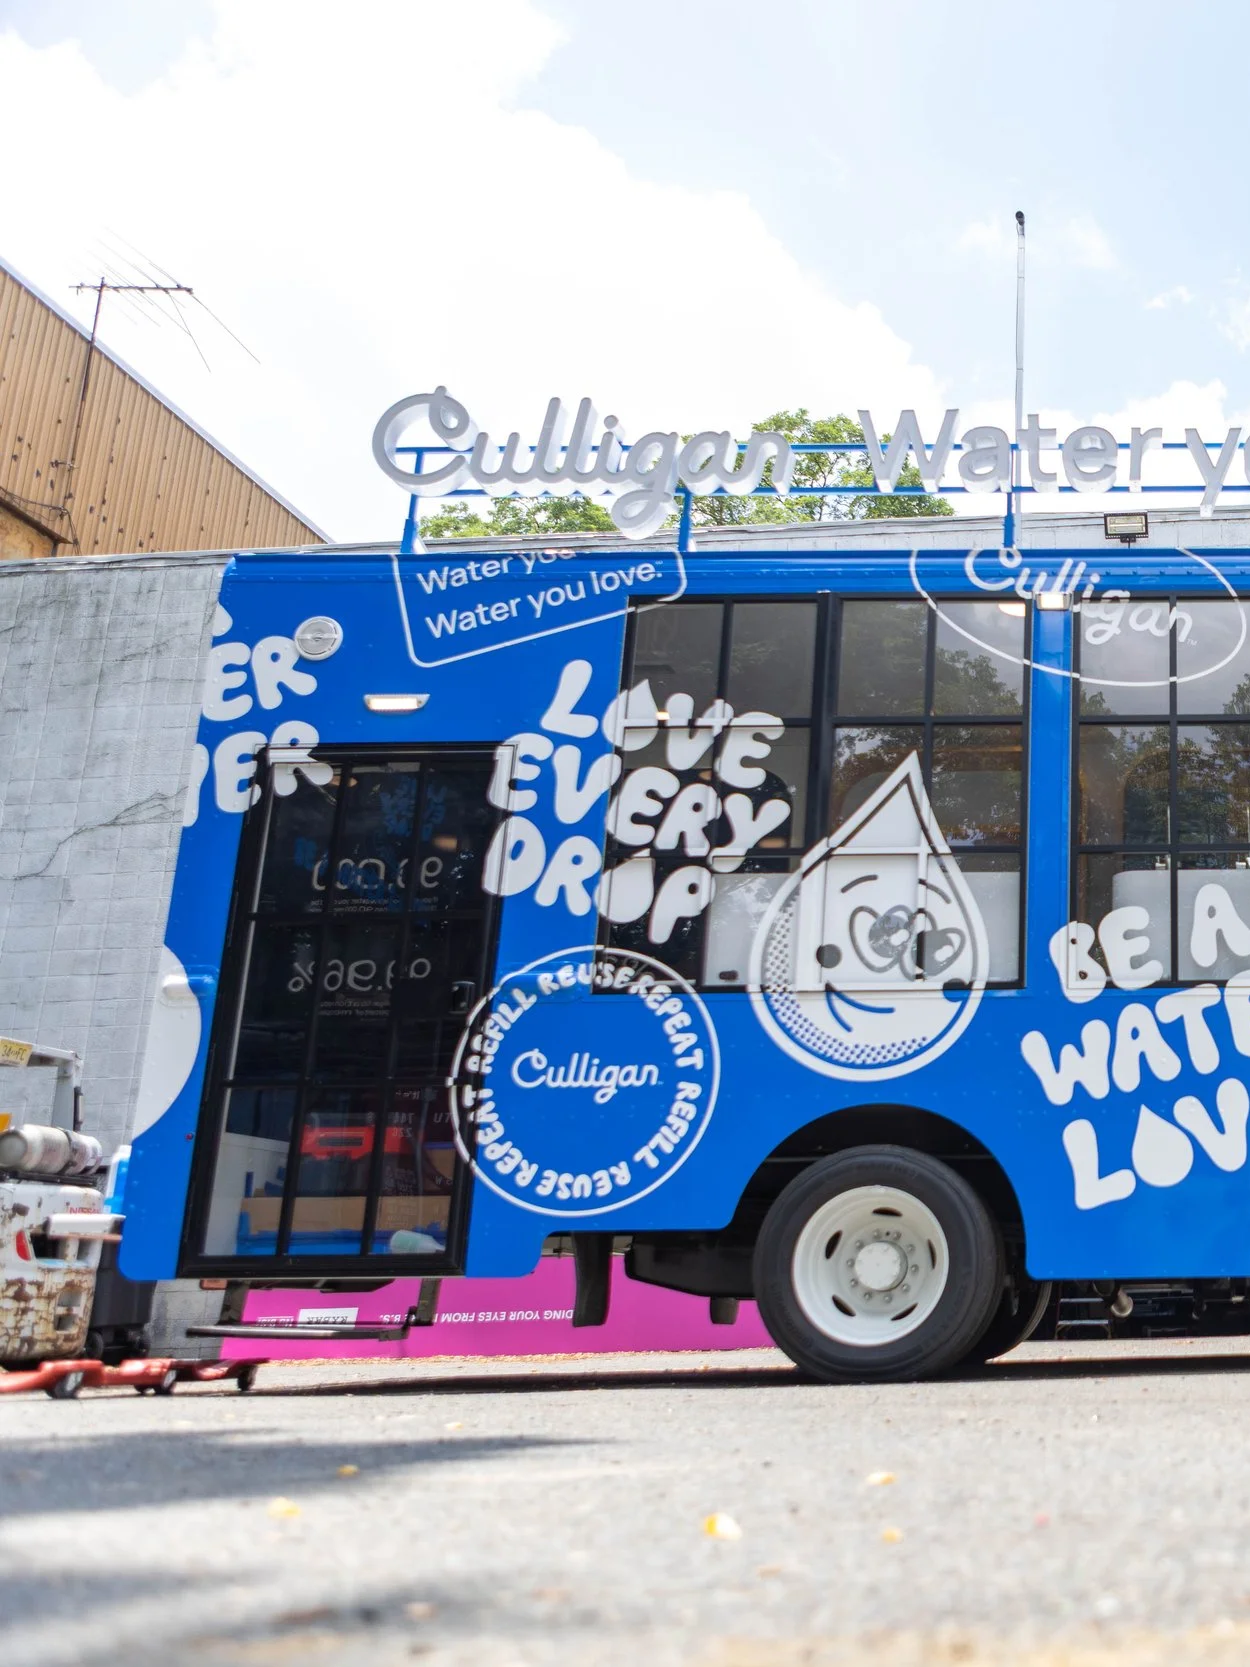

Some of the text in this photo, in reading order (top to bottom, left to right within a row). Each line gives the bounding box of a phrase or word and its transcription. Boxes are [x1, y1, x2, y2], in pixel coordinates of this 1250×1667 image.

[372, 385, 796, 539] Culligan
[857, 407, 1162, 493] Water
[417, 557, 513, 594] Water
[425, 597, 521, 639] Water
[527, 580, 587, 619] you
[488, 732, 791, 873] EVERY
[482, 815, 716, 944] DROP
[537, 963, 635, 995] REUSE
[1049, 906, 1164, 1004] BE
[465, 987, 537, 1074] REFILL
[629, 974, 704, 1070] REPEAT
[511, 1048, 660, 1104] Culligan
[463, 1083, 538, 1188] REPEAT
[633, 1081, 702, 1169] REFILL
[535, 1161, 632, 1200] REUSE
[441, 1312, 475, 1322] FROM
[477, 1311, 506, 1322] EYES
[509, 1310, 541, 1321] YOUR
